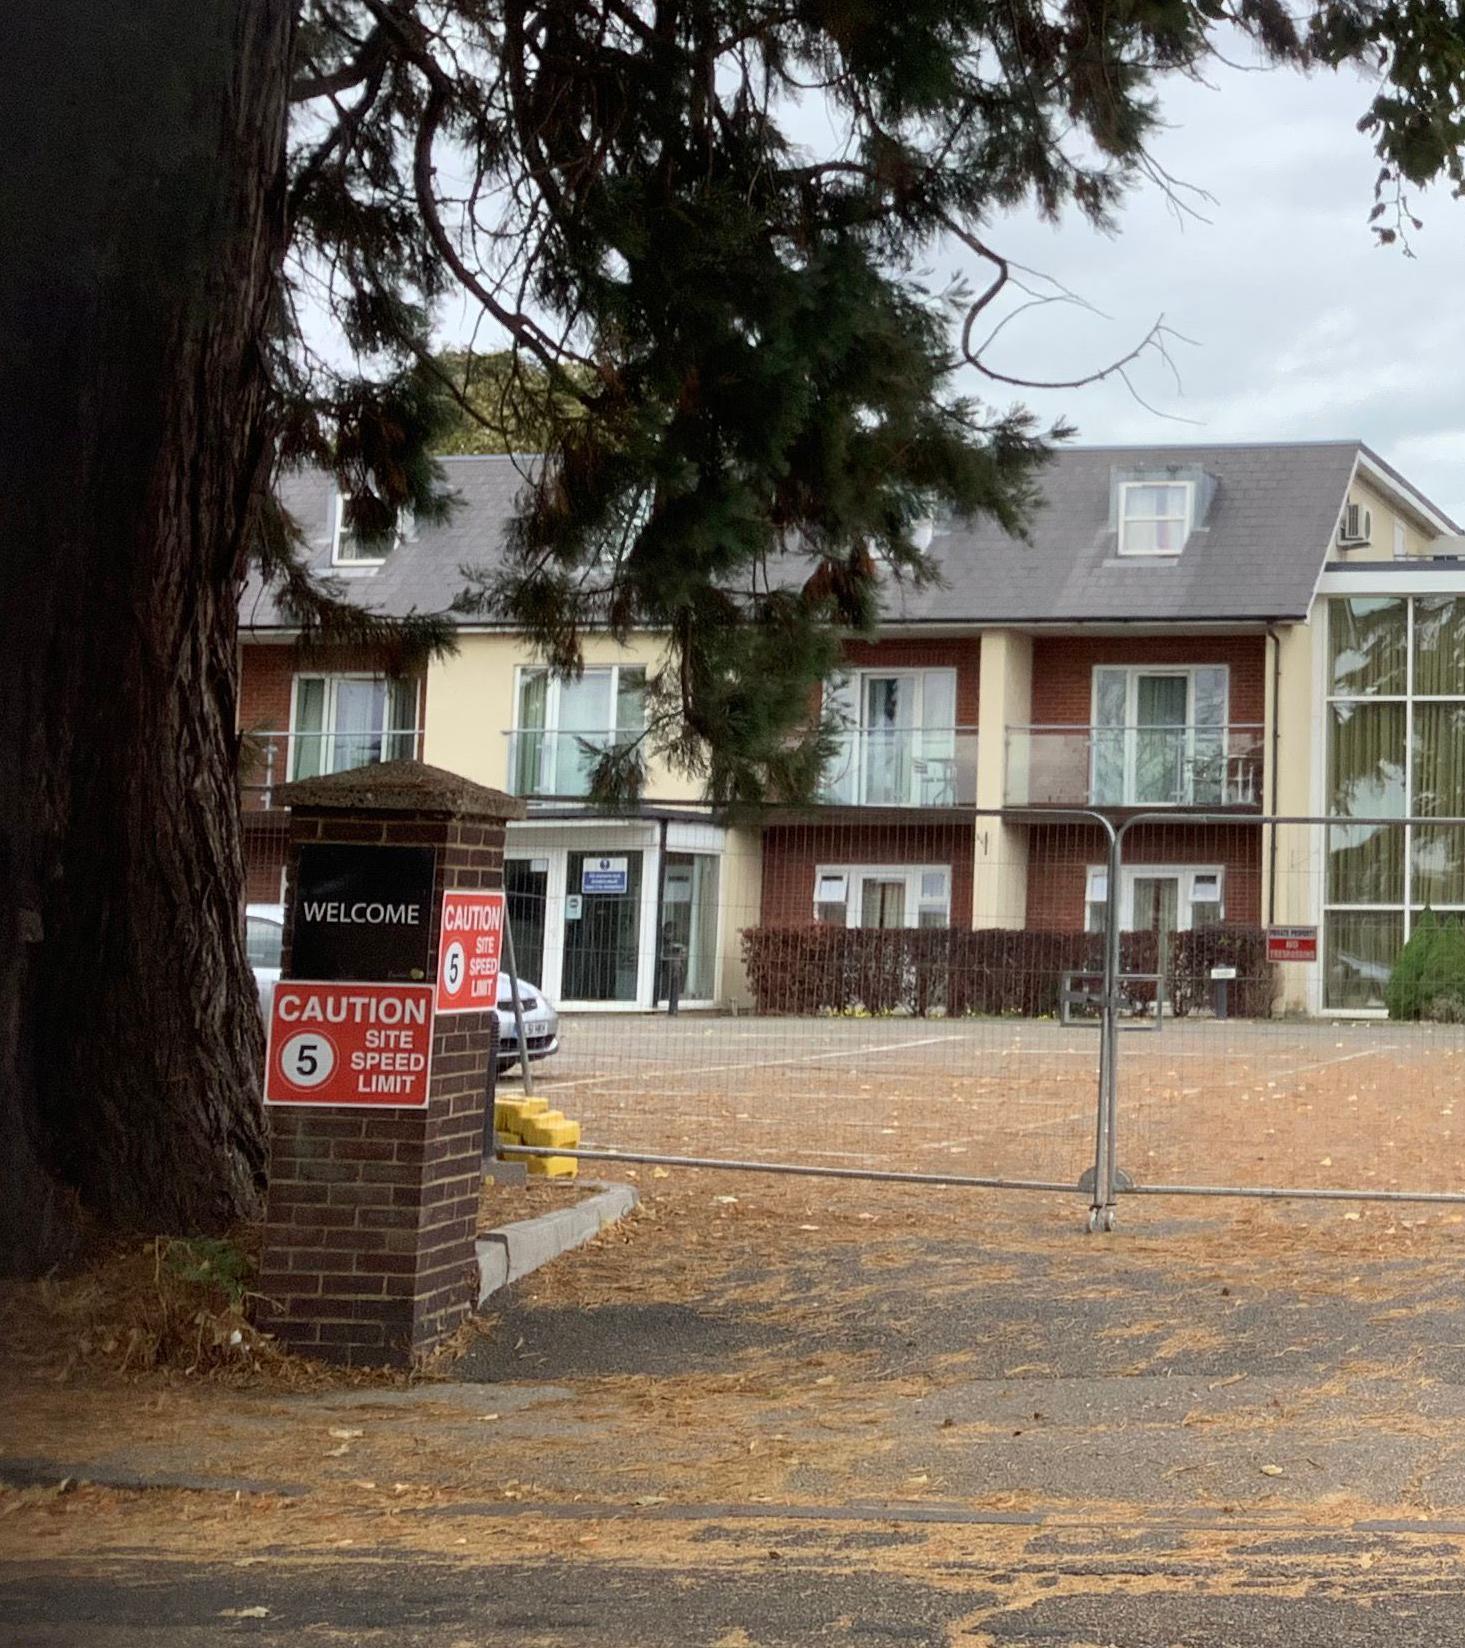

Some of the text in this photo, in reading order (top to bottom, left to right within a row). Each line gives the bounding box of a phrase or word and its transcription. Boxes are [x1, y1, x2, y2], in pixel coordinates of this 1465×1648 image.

[303, 901, 420, 925] WELCOME
[445, 904, 501, 932] CAUTION
[475, 936, 495, 955] SITE
[449, 953, 459, 984] 5
[469, 957, 497, 976] SPEED
[471, 979, 493, 997] LIMIT
[278, 995, 426, 1024] CAUTION
[365, 1030, 413, 1049] SITE
[296, 1045, 318, 1076] 5
[350, 1052, 425, 1071] SPEED
[358, 1074, 416, 1094] LIMIT
